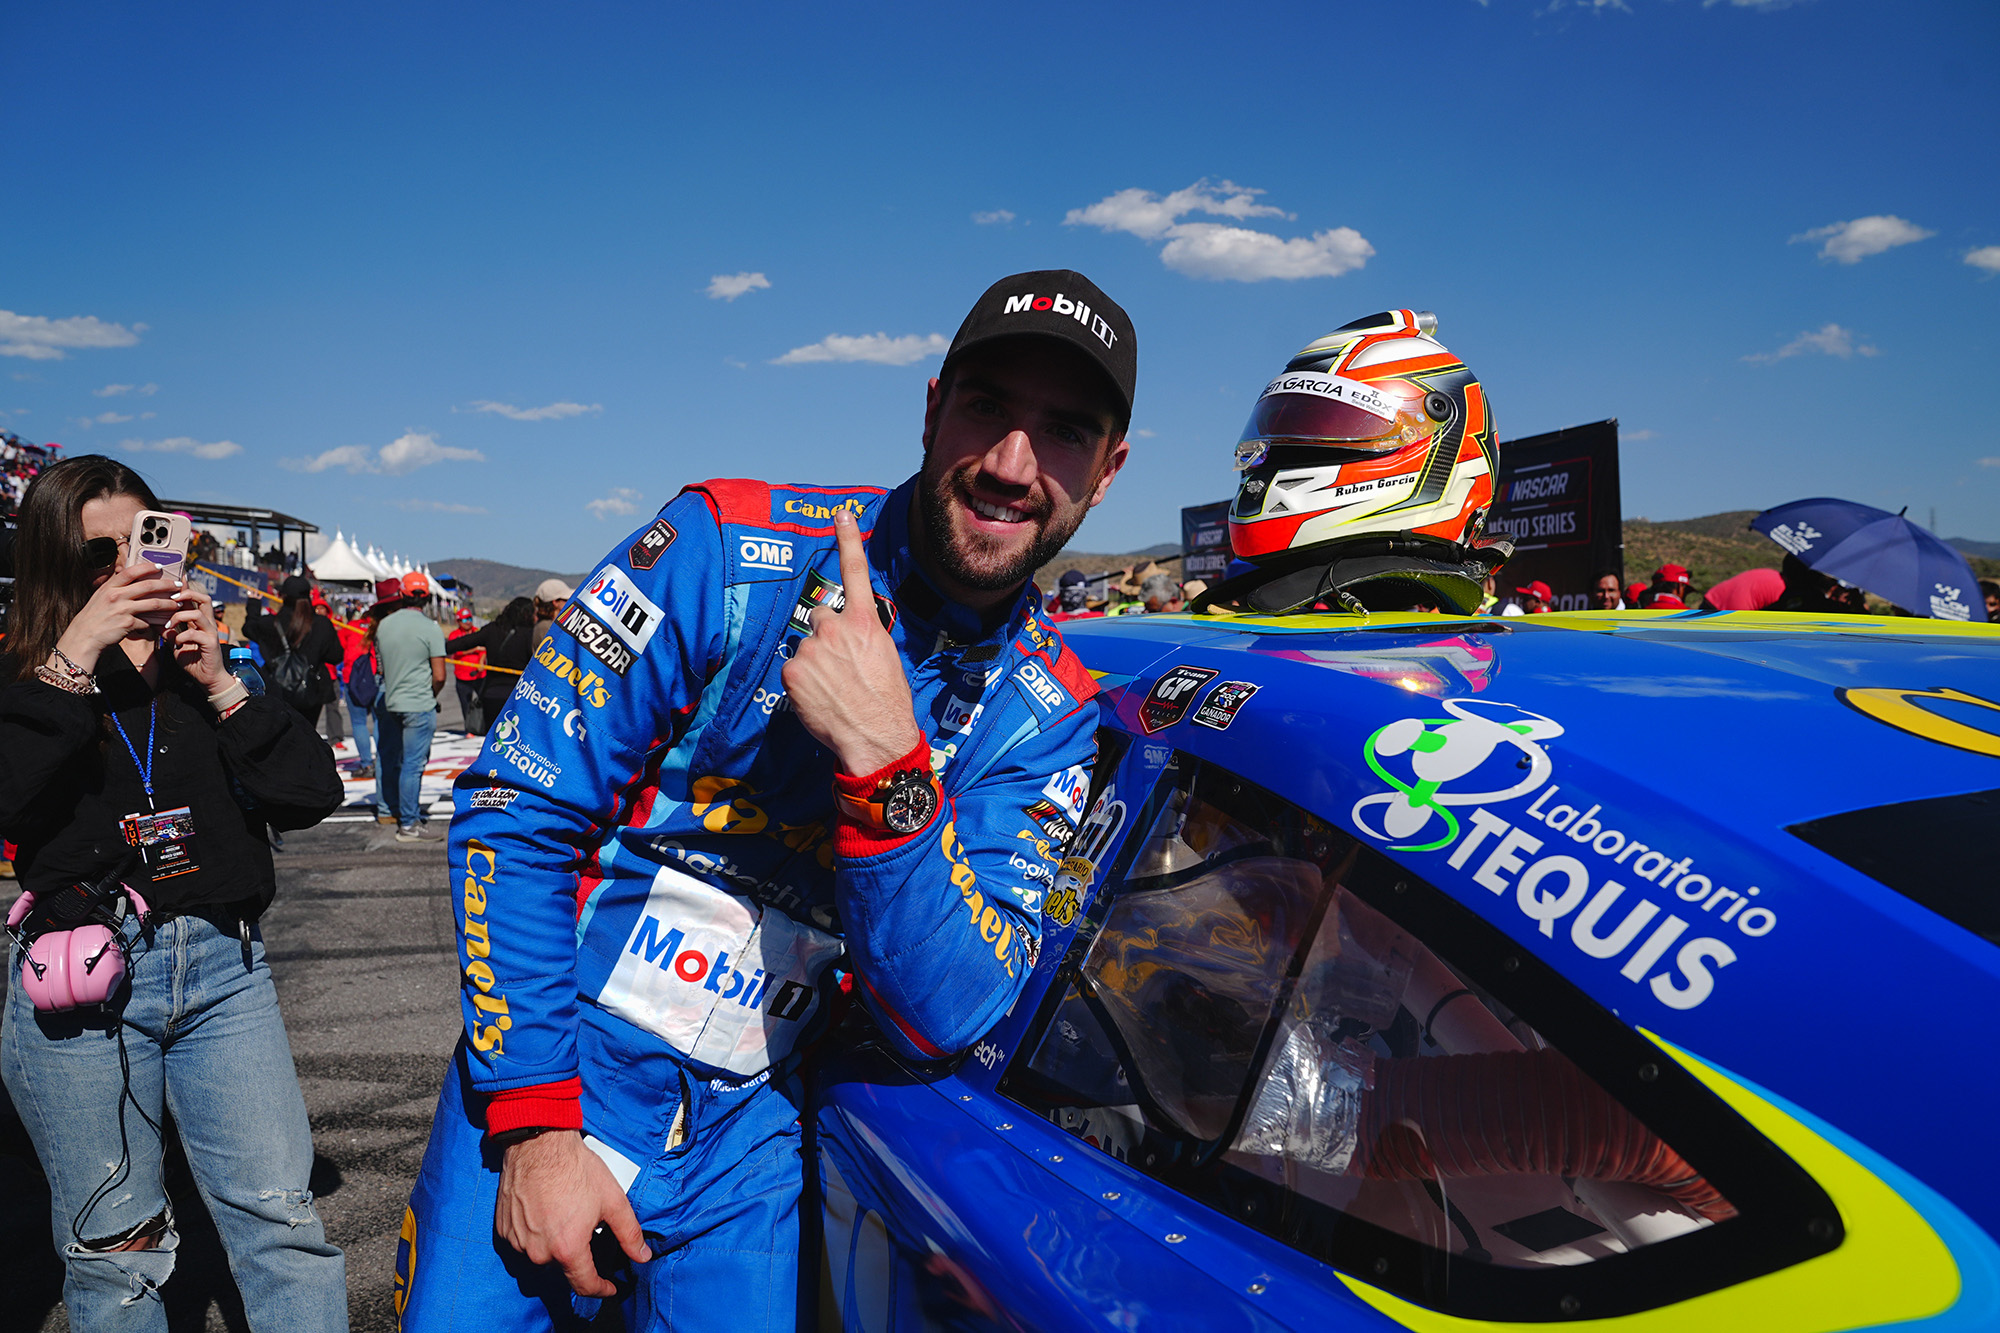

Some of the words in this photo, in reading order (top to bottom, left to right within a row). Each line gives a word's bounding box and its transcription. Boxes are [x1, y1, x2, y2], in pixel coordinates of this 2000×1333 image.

[1003, 293, 1091, 326] Mobil
[1283, 376, 1343, 398] GARCIA
[1351, 390, 1394, 413] EDOX
[1335, 484, 1373, 498] Ruben
[1377, 475, 1415, 489] Garcia
[1511, 472, 1569, 502] NASCAR
[785, 499, 866, 519] Canel's
[1531, 511, 1576, 538] SERIES
[740, 546, 794, 566] OMP
[563, 608, 632, 675] NASCAR
[534, 636, 612, 709] Canel's
[1019, 664, 1062, 707] OMP
[1176, 668, 1209, 679] Team
[945, 703, 980, 729] Mob
[1200, 706, 1231, 723] GANADOR
[503, 745, 557, 788] TEQUIS
[517, 738, 562, 775] Laboratorio
[1053, 769, 1086, 813] Mob
[1009, 851, 1054, 894] logite
[1525, 784, 1777, 937] Laboratorio
[1041, 887, 1079, 925] el's
[1446, 807, 1738, 1010] TEQUIS
[464, 838, 512, 1056] Canel's
[629, 915, 776, 1010] Mobil
